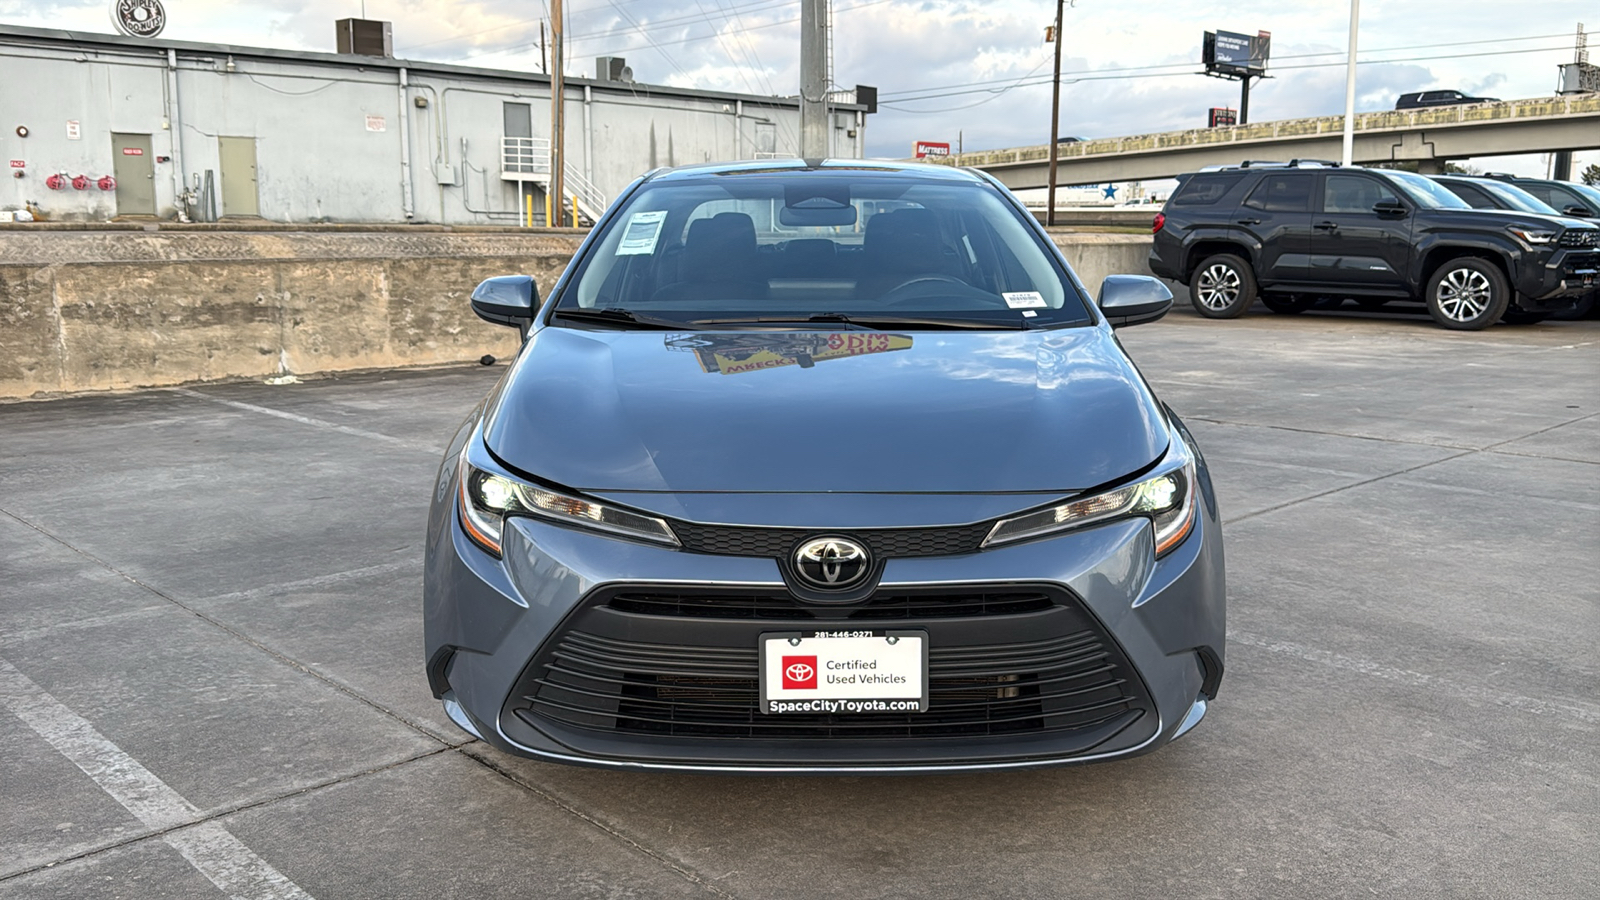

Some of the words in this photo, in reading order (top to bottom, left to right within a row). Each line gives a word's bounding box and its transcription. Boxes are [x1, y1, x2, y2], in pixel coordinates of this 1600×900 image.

[918, 144, 948, 154] MATTRESS
[826, 659, 877, 670] Certified
[826, 674, 856, 684] Used
[859, 674, 907, 684] Vehicles
[769, 699, 920, 714] SpaceCityToyota.com
